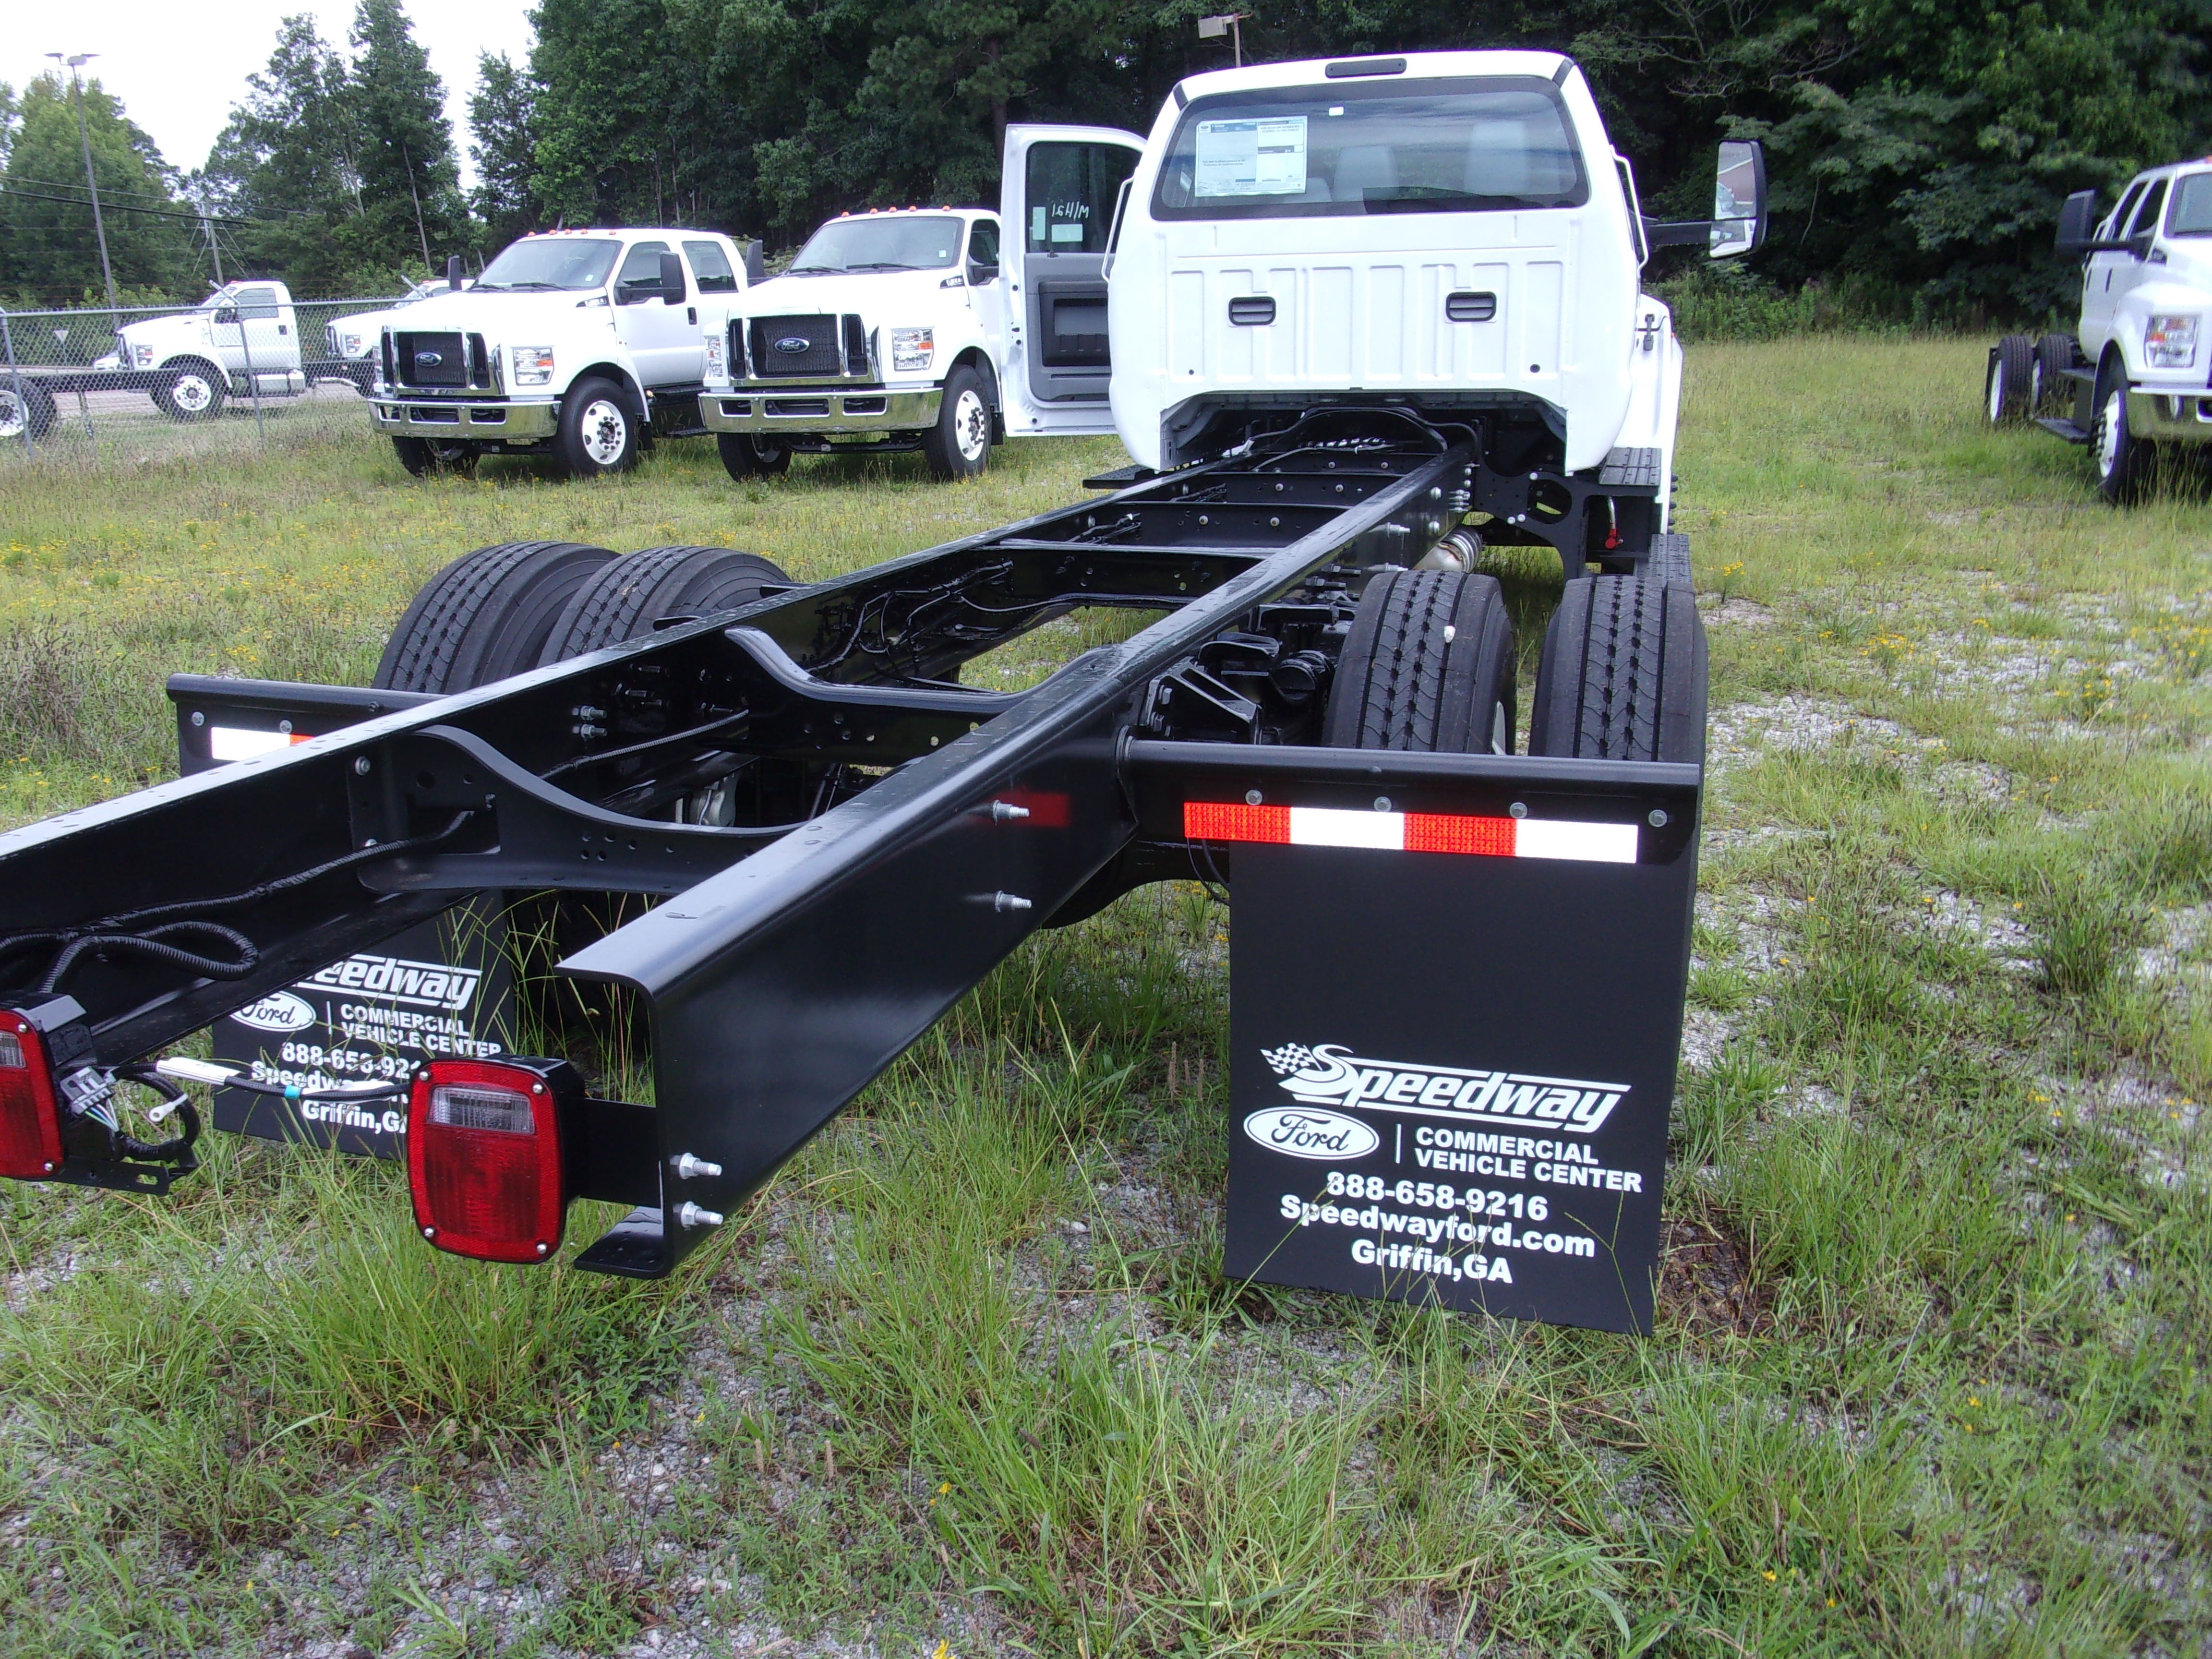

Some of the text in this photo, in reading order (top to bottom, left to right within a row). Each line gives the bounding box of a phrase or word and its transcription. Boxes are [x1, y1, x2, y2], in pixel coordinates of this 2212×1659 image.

[306, 958, 478, 1010] eedway
[341, 1004, 469, 1036] COMMERCIAL
[341, 1022, 421, 1048] VEHICLE
[282, 1042, 421, 1079] 888-658-92
[1278, 1044, 1622, 1133] Speedway
[1271, 1113, 1350, 1152] Ford
[1416, 1127, 1599, 1165] COMMERCIAL
[1415, 1149, 1642, 1192] VEHICLE CENTER
[1326, 1171, 1548, 1221] 888-658-9216
[1280, 1195, 1595, 1257] Speedwayford.com
[1351, 1239, 1513, 1284] Griffin,GA
